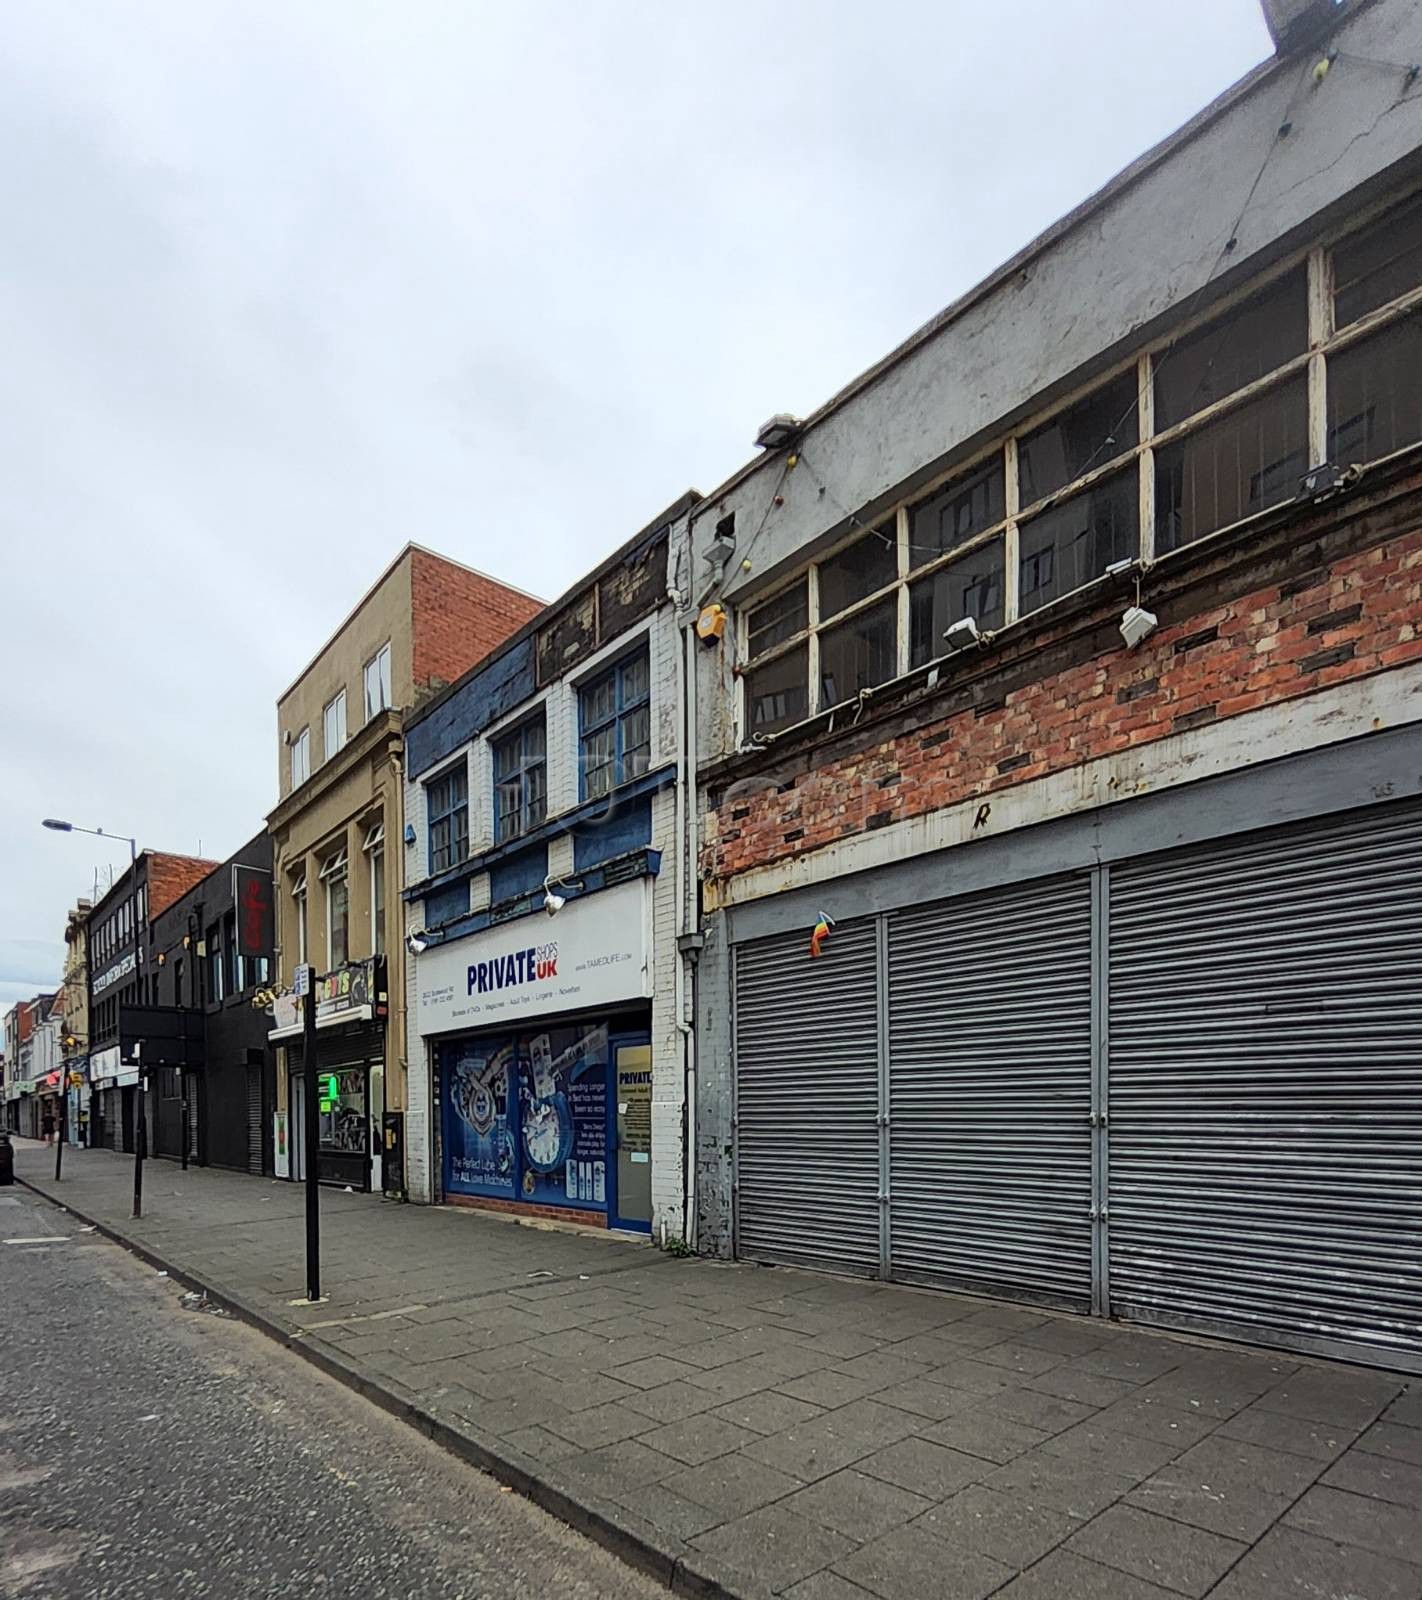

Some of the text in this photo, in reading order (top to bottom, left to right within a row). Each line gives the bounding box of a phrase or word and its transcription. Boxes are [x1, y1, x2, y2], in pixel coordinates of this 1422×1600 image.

[537, 941, 558, 961] SHOPS
[467, 948, 536, 996] PRIVATE
[537, 959, 558, 979] UK
[619, 1072, 652, 1085] PRIVATE
